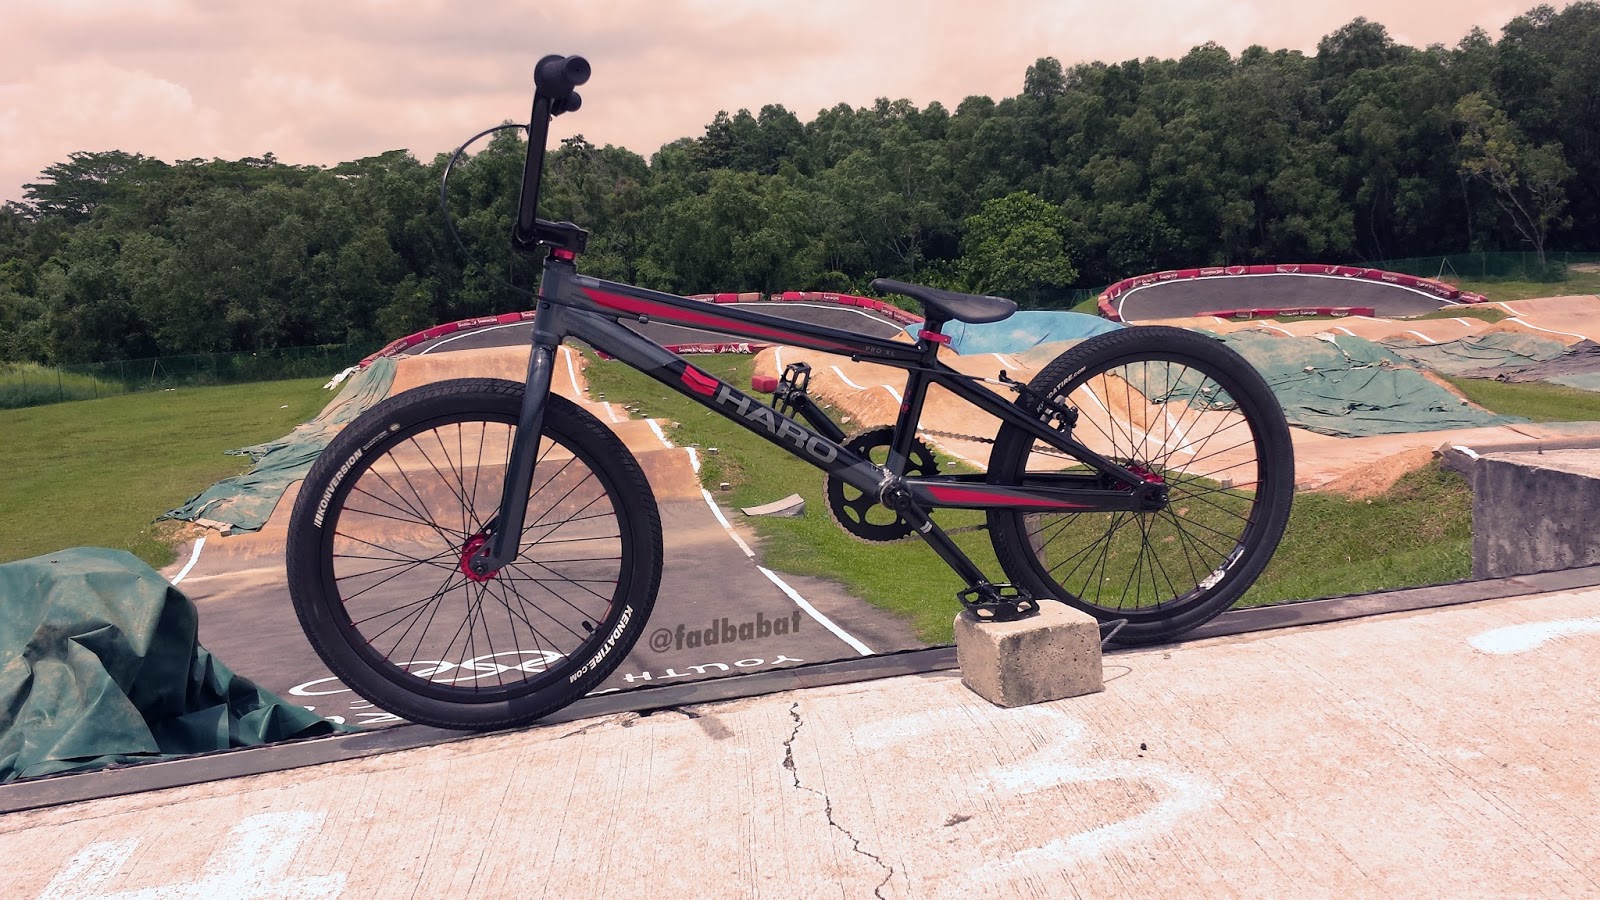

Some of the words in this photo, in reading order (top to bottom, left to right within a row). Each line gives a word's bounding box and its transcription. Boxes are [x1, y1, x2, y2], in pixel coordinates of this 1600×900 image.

[865, 345, 882, 354] PRO
[886, 349, 895, 357] XL
[715, 384, 838, 463] HARO
[315, 447, 363, 520] KONVERSION
[569, 604, 634, 684] KENDATIRE.COM
[622, 655, 804, 683] YOUTH
